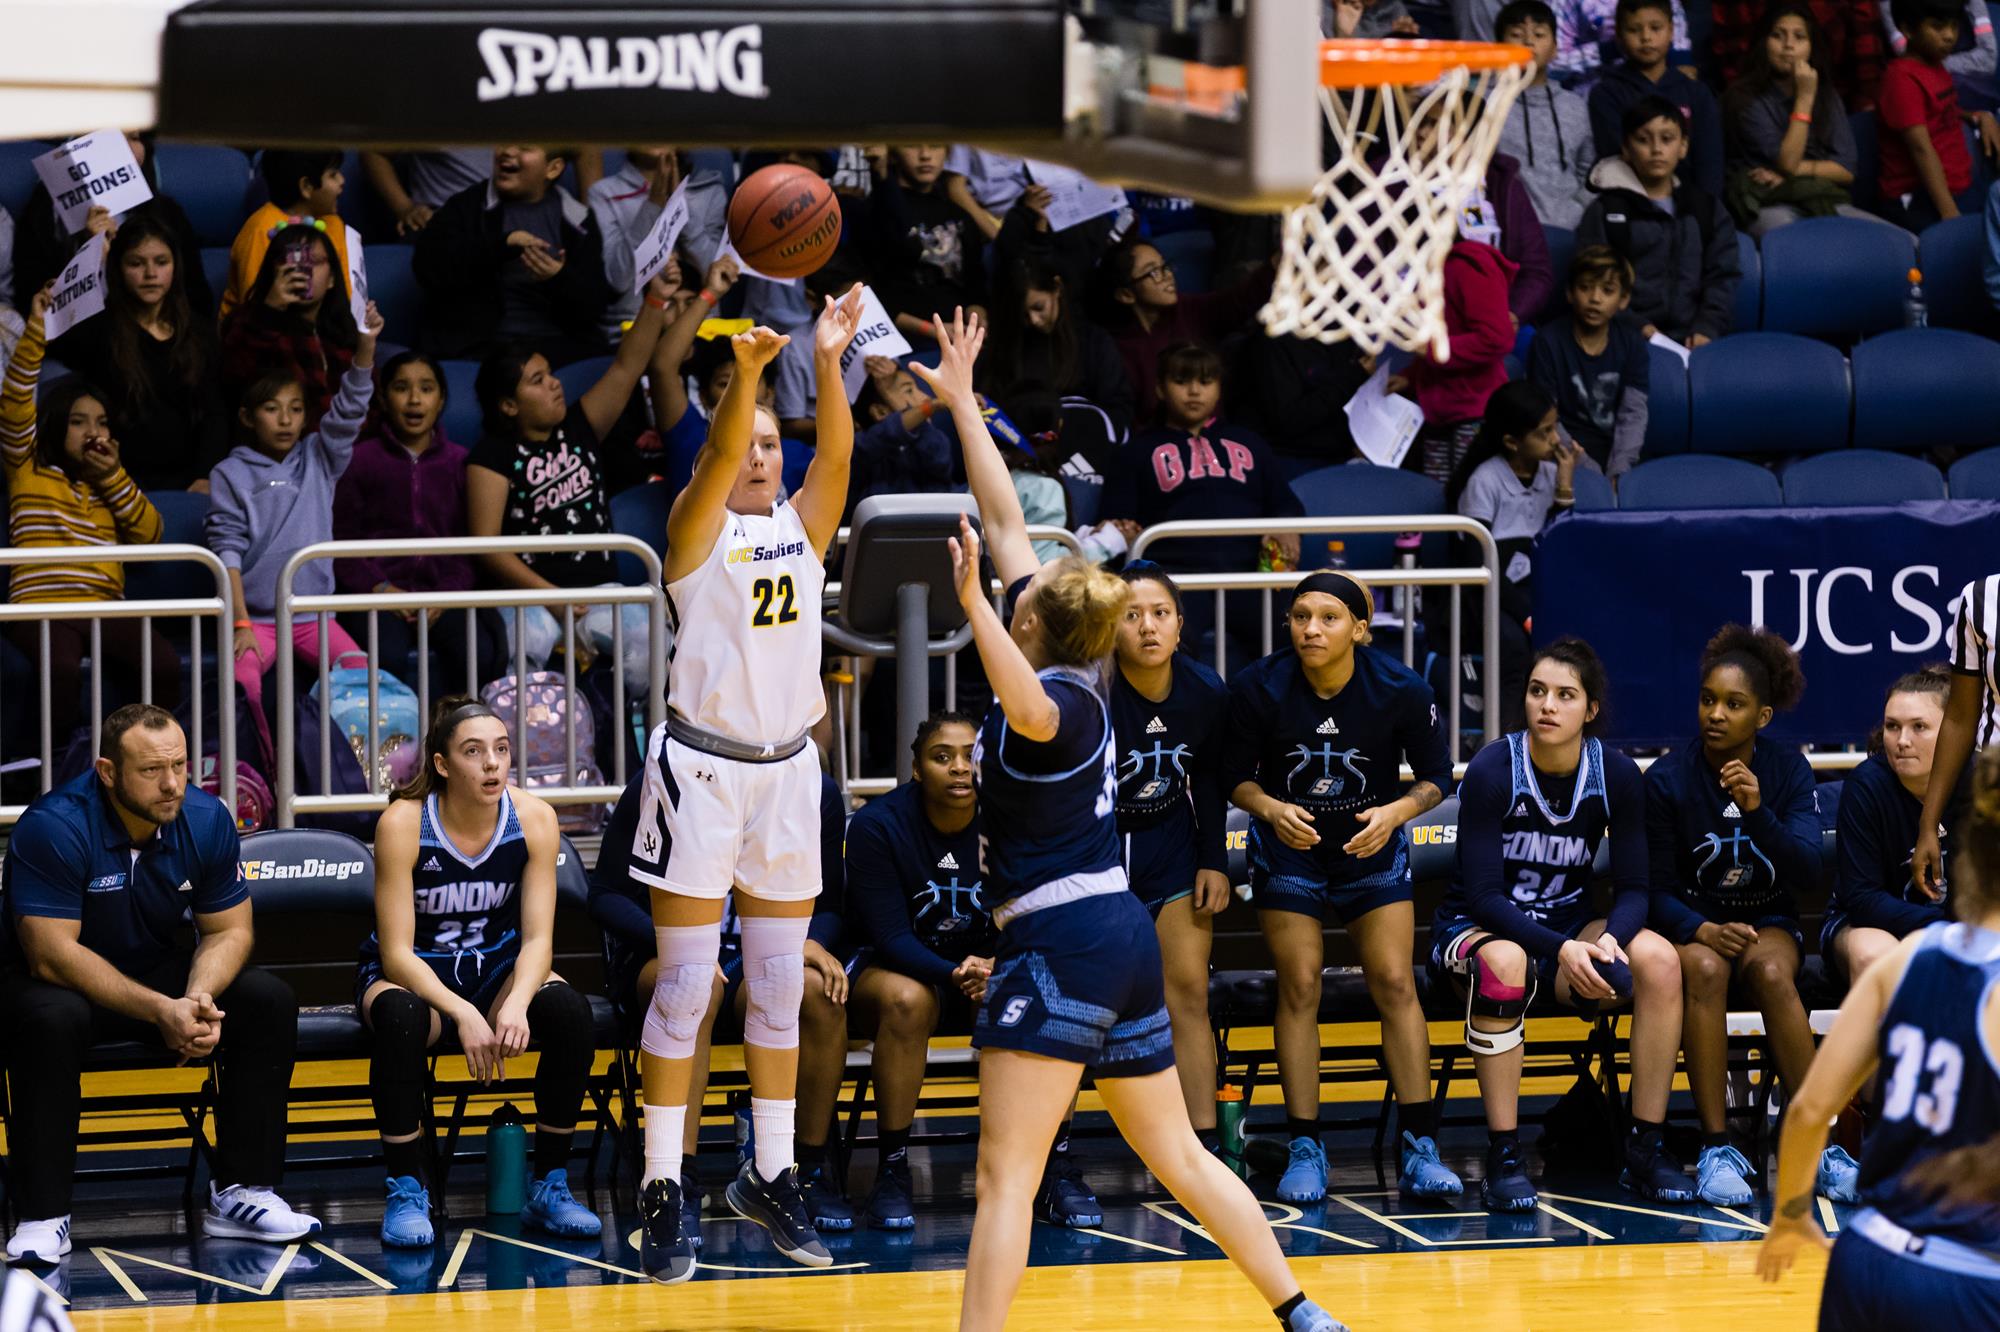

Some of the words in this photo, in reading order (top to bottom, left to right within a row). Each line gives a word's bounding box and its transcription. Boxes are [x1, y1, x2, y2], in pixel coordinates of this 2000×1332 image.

[477, 24, 763, 102] SPALDING
[56, 163, 137, 211] TRITONS!
[67, 161, 91, 182] GO
[770, 189, 817, 231] NCAA
[778, 210, 839, 259] Wilson
[64, 263, 80, 285] GO
[1152, 436, 1254, 493] GAP
[534, 465, 594, 514] POWER
[751, 573, 799, 628] 22
[1741, 566, 1873, 655] UC
[1316, 727, 1340, 735] adidas
[240, 859, 364, 881] CSanDiego
[938, 862, 960, 870] adidas
